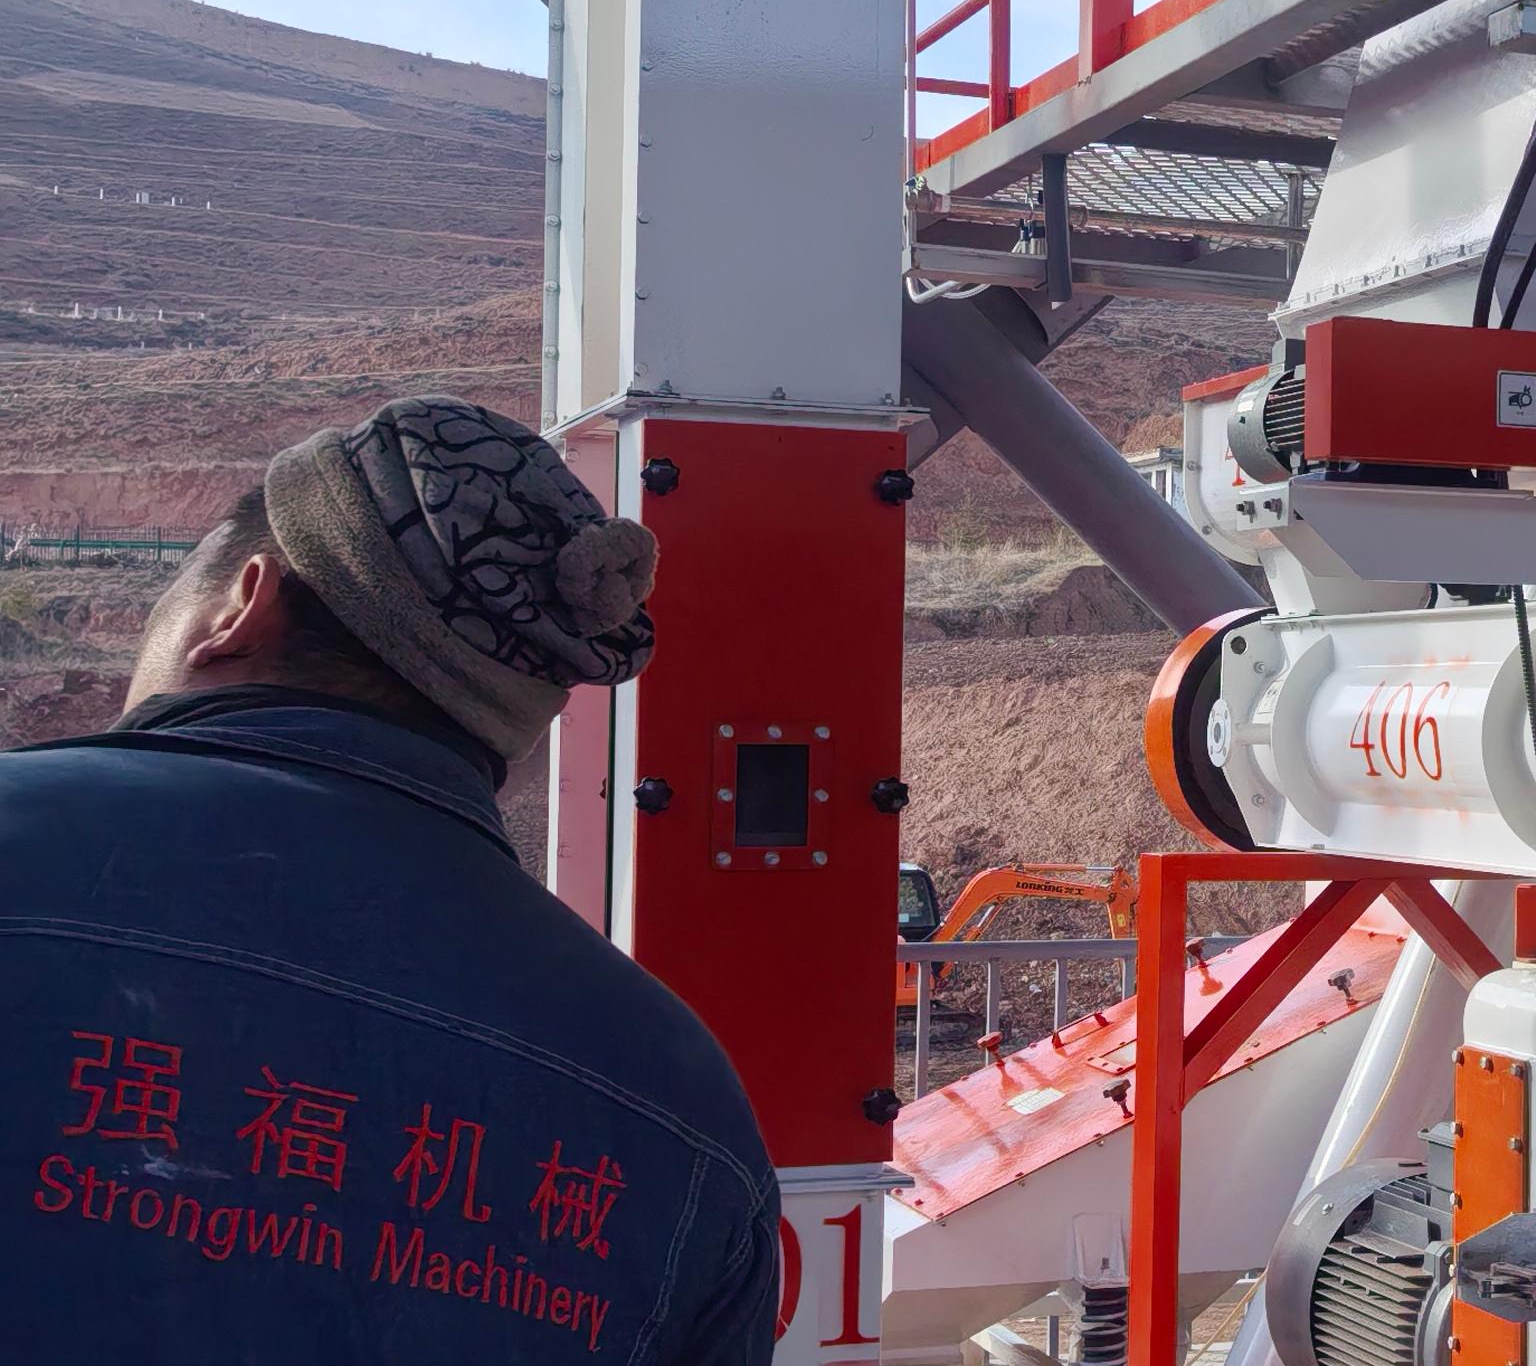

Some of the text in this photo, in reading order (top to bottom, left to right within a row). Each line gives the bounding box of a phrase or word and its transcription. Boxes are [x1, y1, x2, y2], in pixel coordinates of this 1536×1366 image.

[1350, 680, 1450, 781] 406
[62, 1031, 627, 1259] 强福机械
[34, 1154, 609, 1353] Strongwin Machinery
